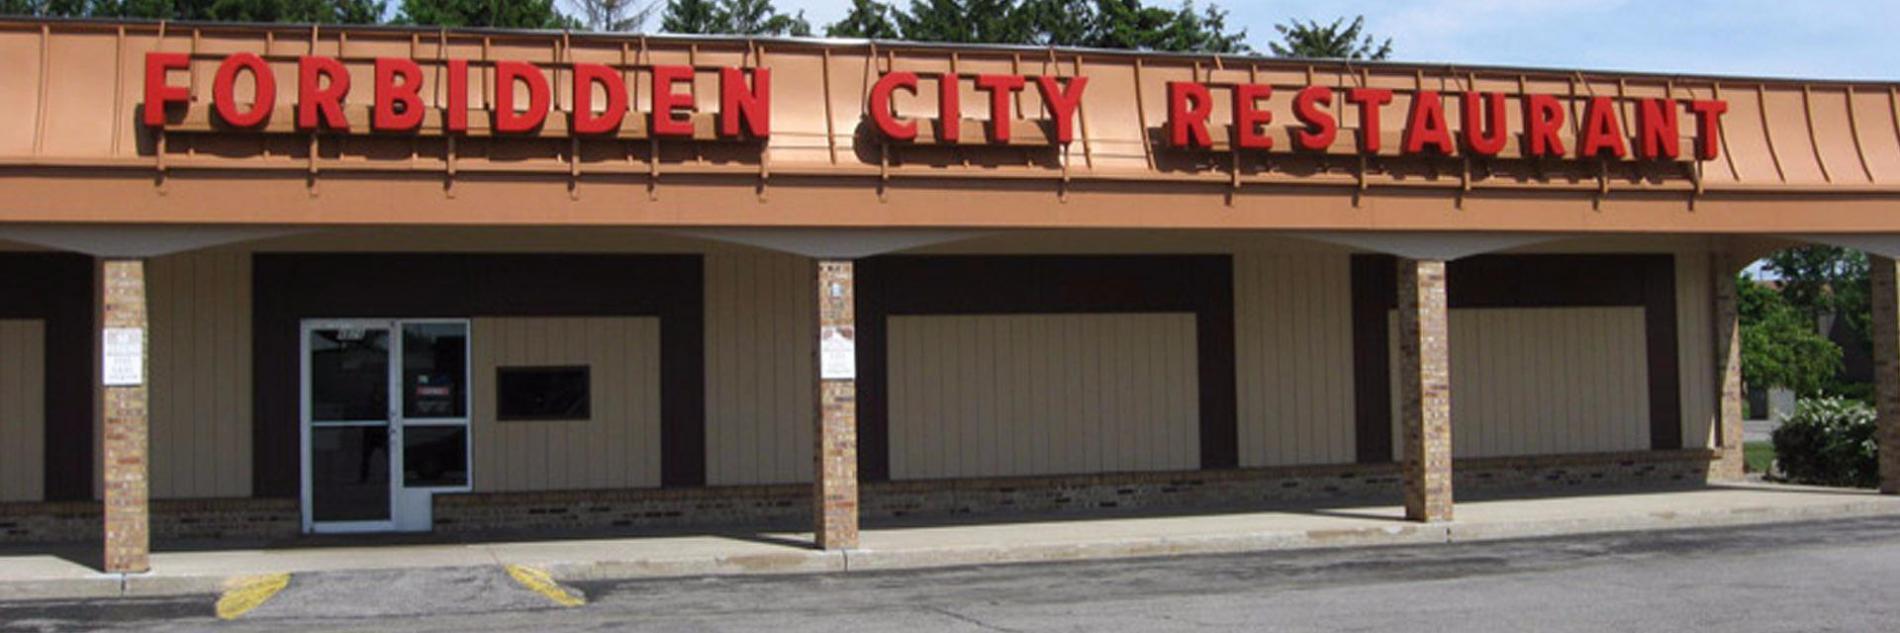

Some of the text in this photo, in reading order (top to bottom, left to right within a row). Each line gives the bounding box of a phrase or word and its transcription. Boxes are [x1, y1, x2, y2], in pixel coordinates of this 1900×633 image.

[142, 52, 1728, 161] FORBIDDEN CITY RESTAURANT
